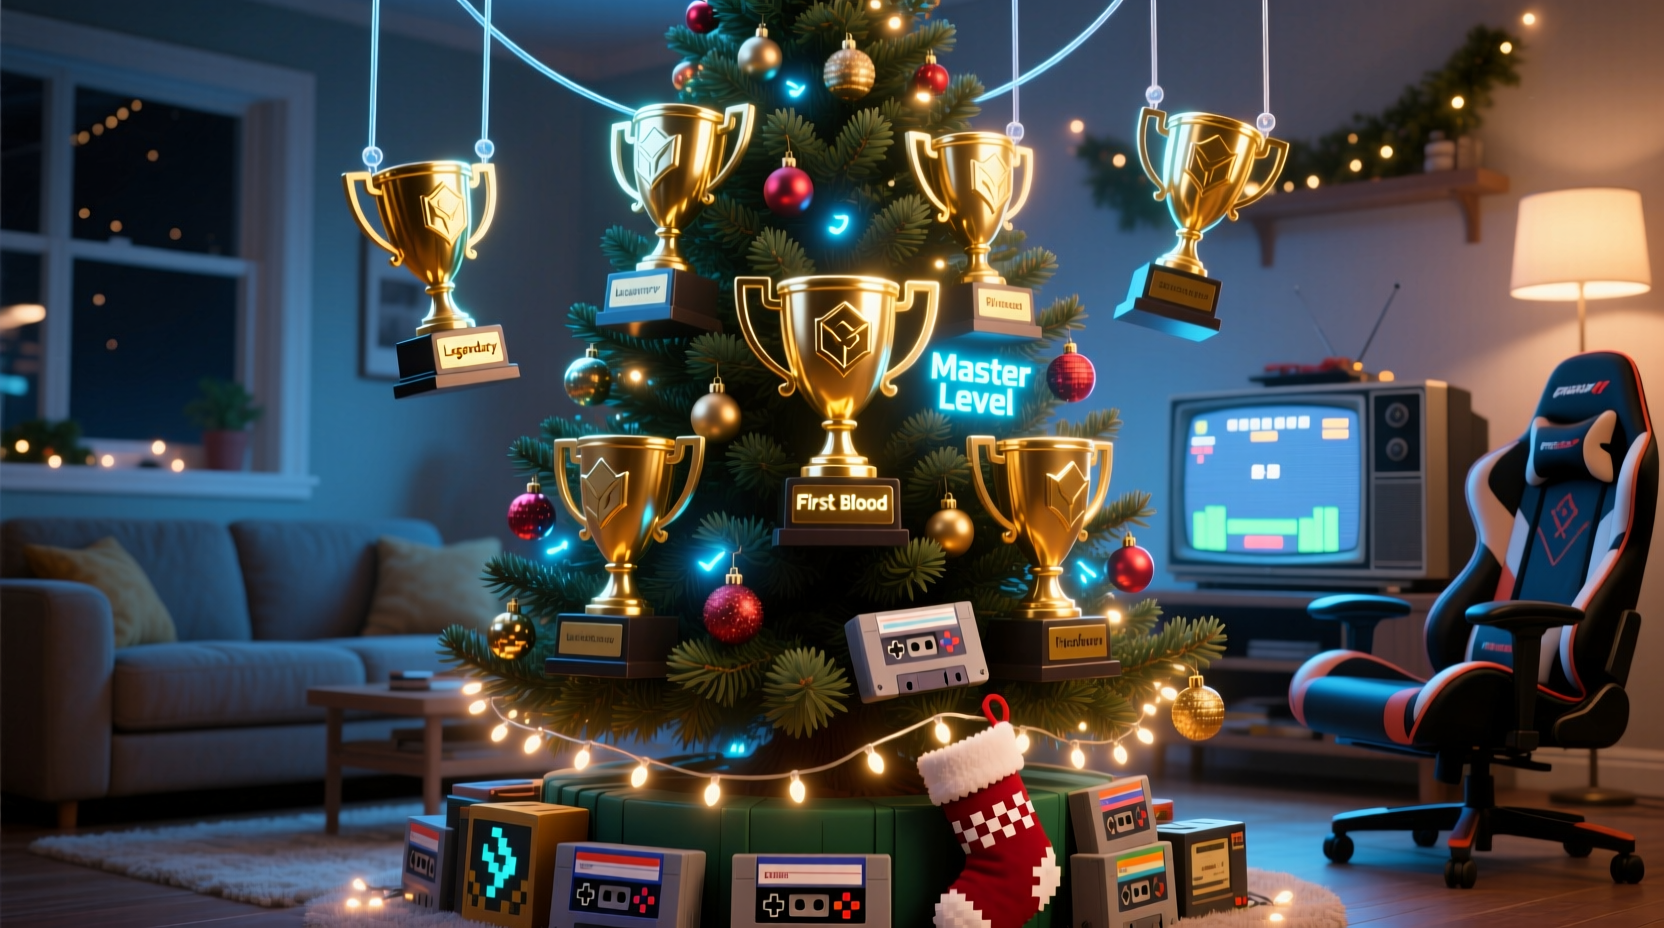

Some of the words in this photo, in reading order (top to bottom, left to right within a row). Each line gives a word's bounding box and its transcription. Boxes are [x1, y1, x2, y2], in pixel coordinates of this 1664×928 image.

[931, 351, 1032, 388] Master
[938, 381, 1014, 417] Level
[796, 493, 837, 511] First
[840, 493, 888, 511] Blood
